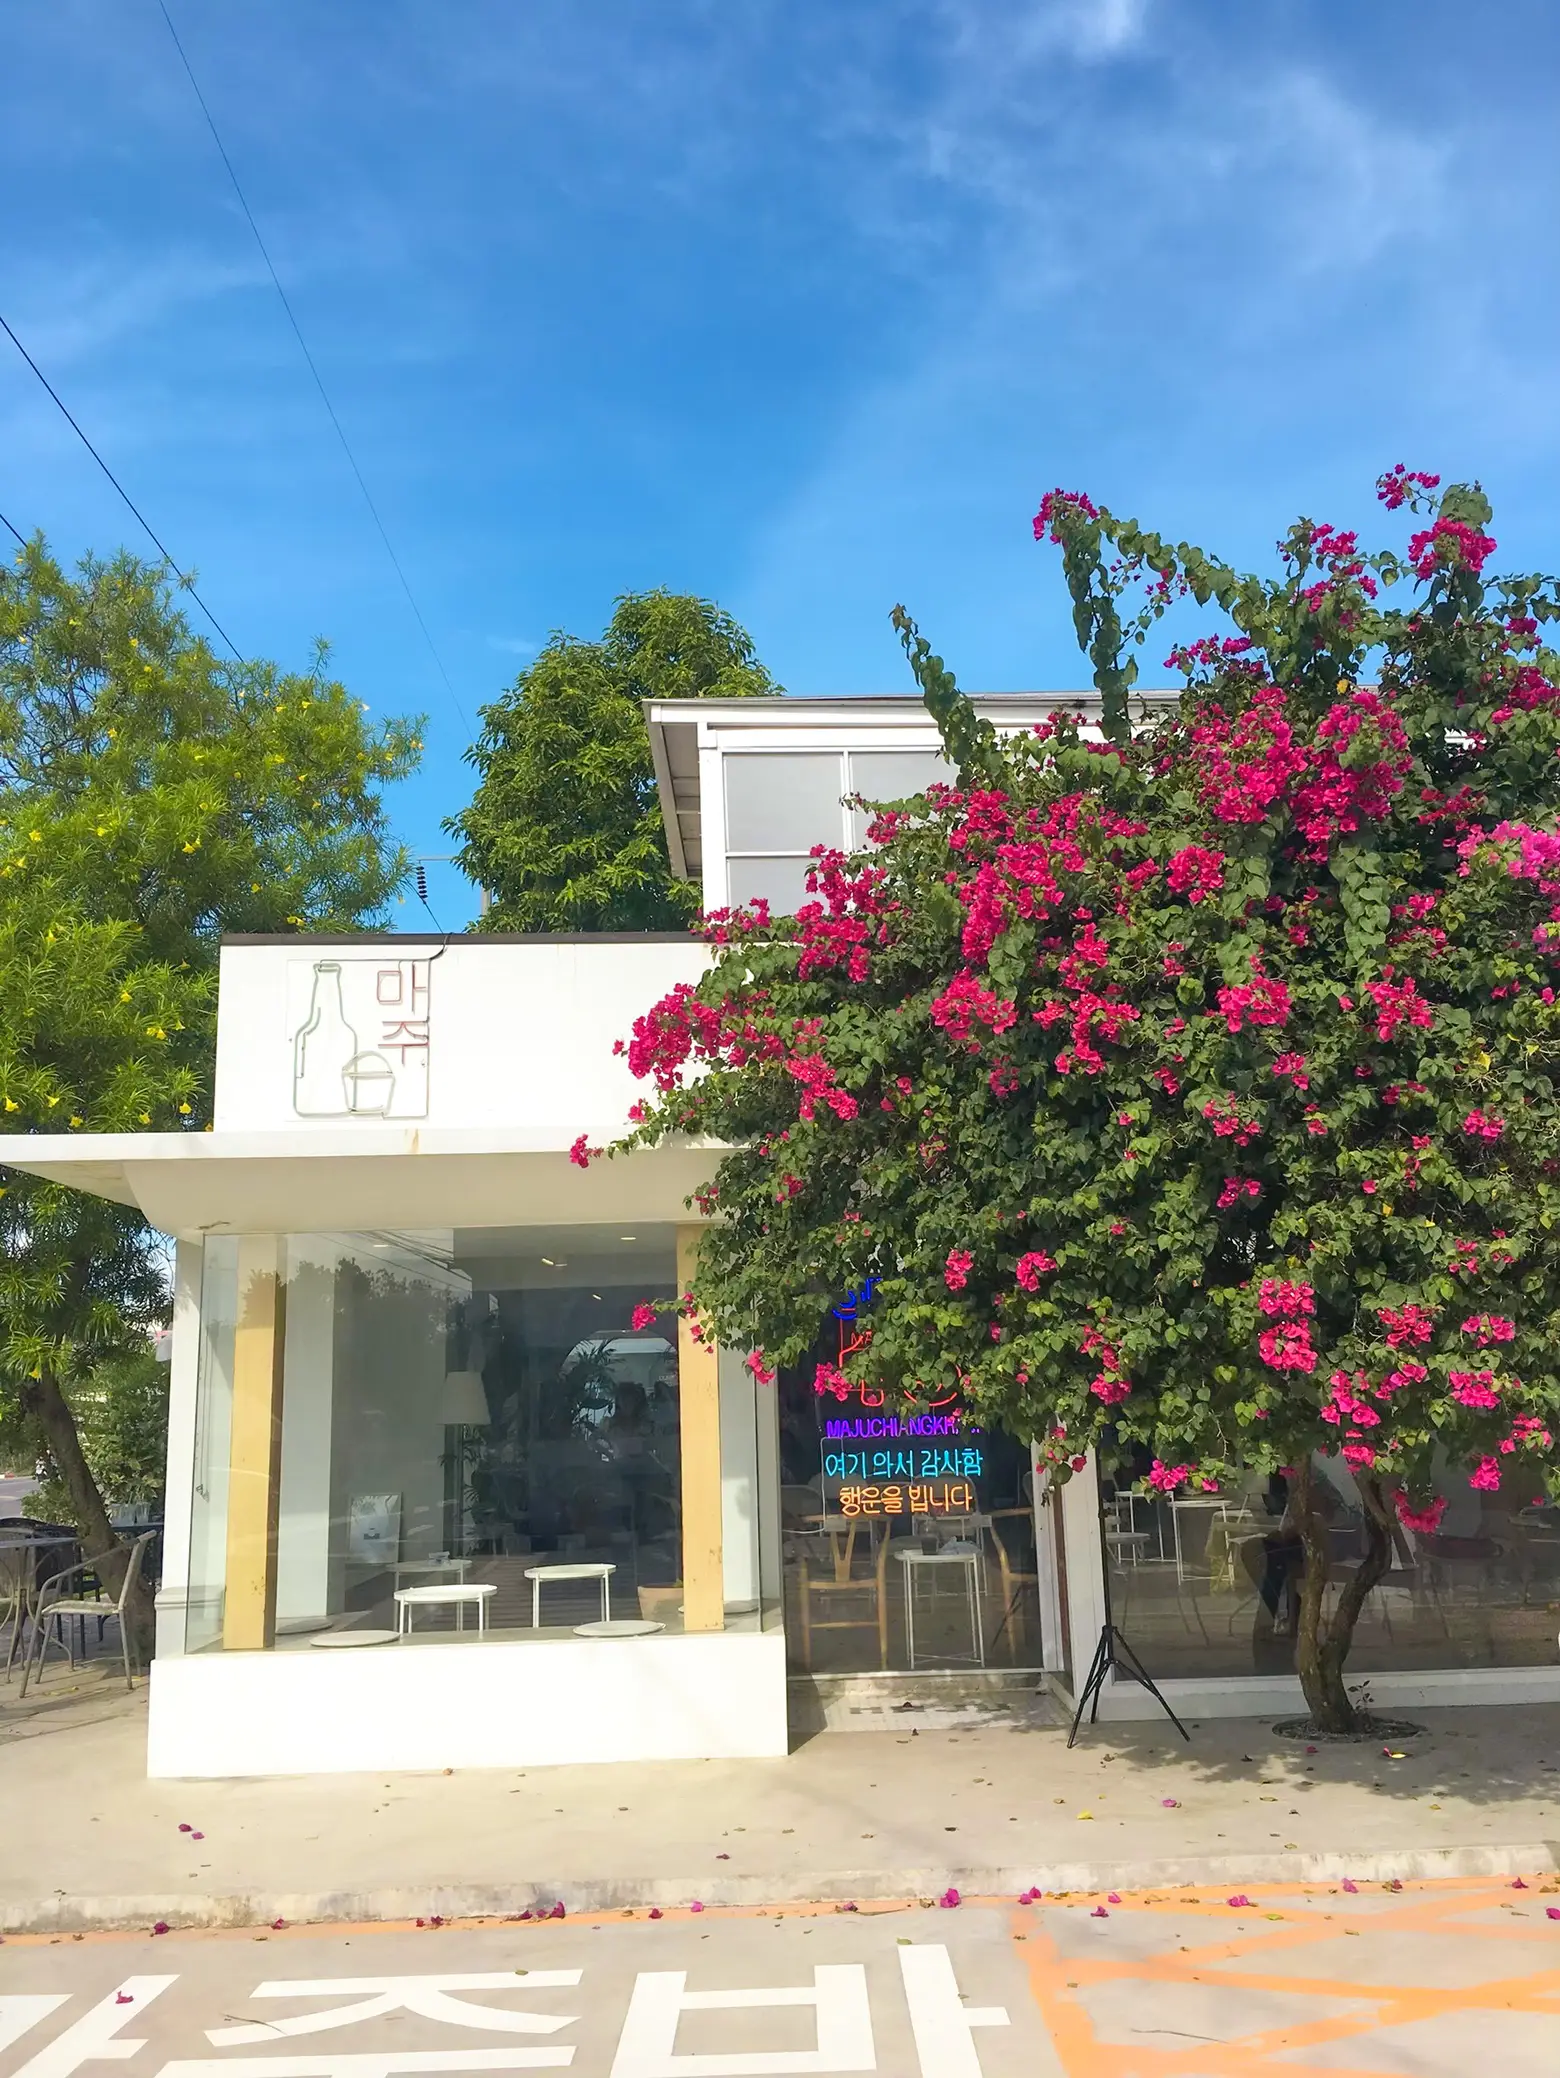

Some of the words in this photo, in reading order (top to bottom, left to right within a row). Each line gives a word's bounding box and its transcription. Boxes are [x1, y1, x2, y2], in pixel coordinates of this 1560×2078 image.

[825, 1451, 867, 1480] 여기
[920, 1448, 984, 1478] 감사함
[839, 1485, 904, 1517] 행운을
[908, 1483, 973, 1513] 빕니다
